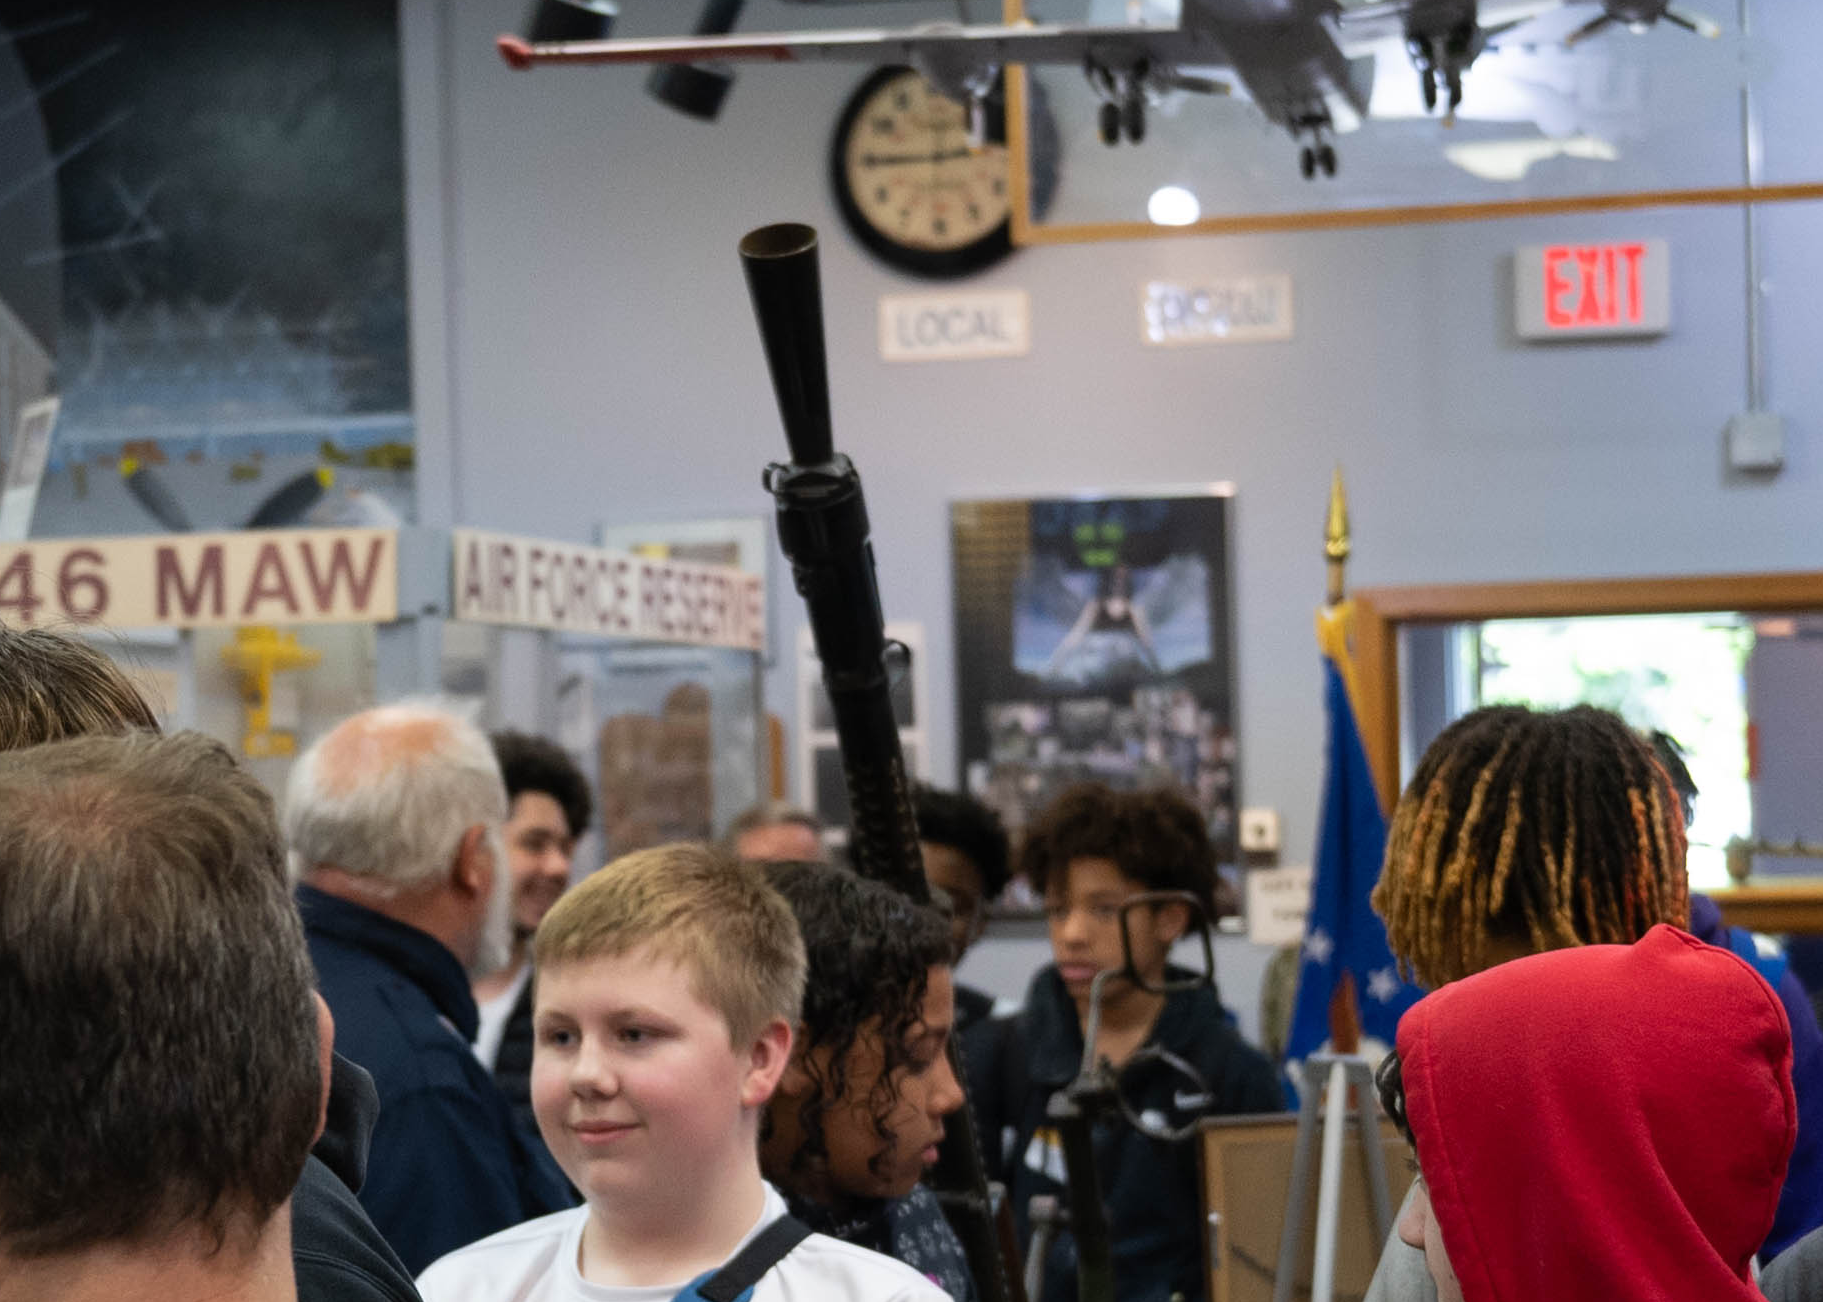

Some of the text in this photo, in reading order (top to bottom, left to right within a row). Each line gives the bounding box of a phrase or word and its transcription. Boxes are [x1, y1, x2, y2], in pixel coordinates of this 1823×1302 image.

[895, 305, 1011, 349] LOCAL
[1543, 243, 1646, 329] EXIT
[153, 536, 385, 620] MAW
[465, 539, 764, 644] AIR FORCE RESERVE
